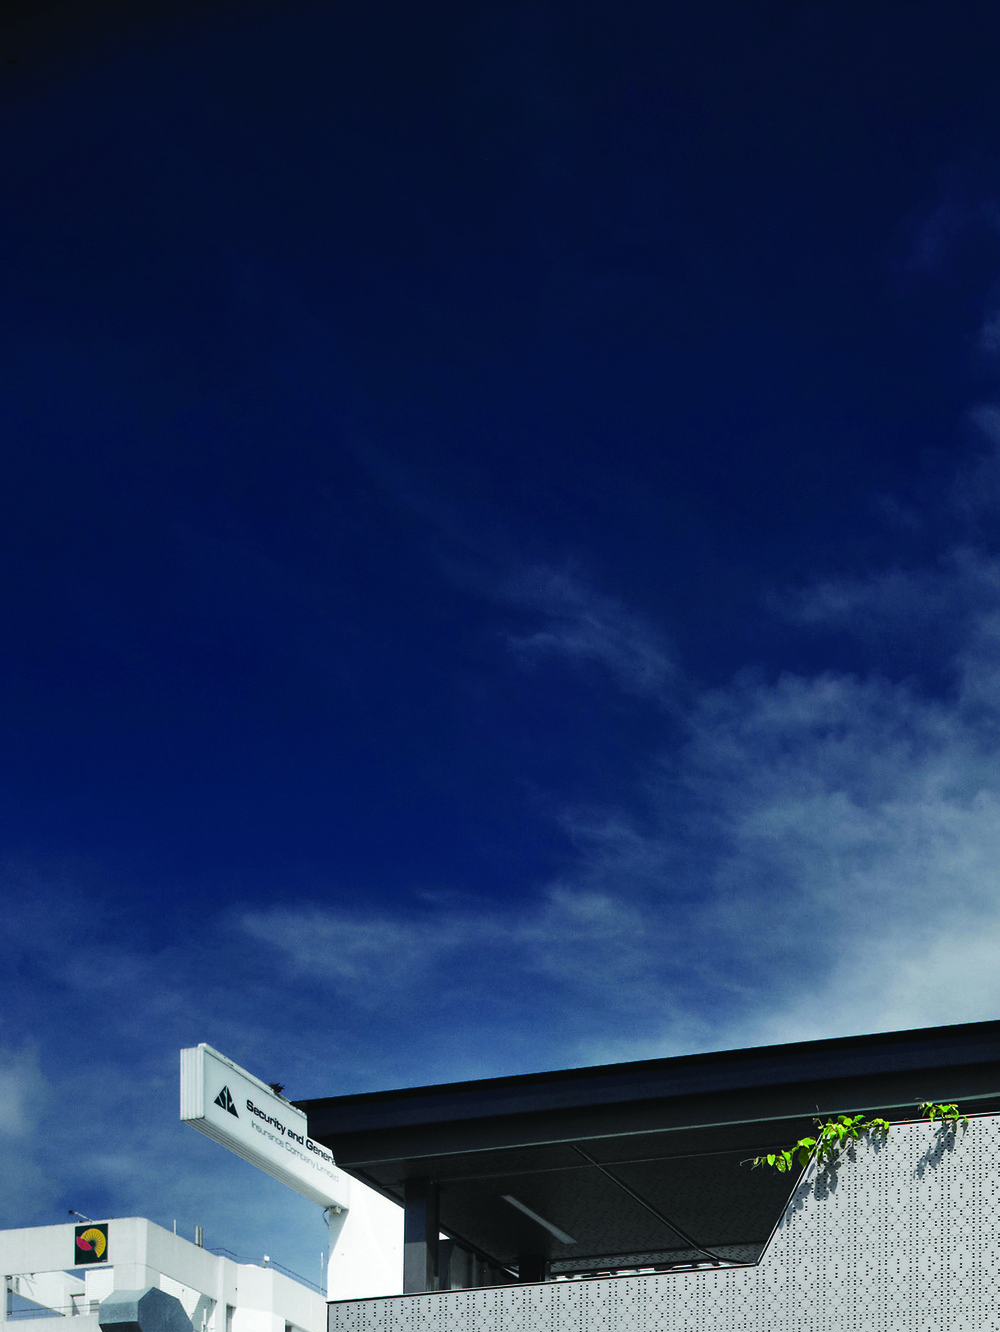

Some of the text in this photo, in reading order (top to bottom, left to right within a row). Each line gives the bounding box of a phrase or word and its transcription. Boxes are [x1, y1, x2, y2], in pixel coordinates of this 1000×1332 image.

[246, 1099, 286, 1135] Security
[288, 1129, 304, 1145] and
[251, 1120, 284, 1148] Insurance
